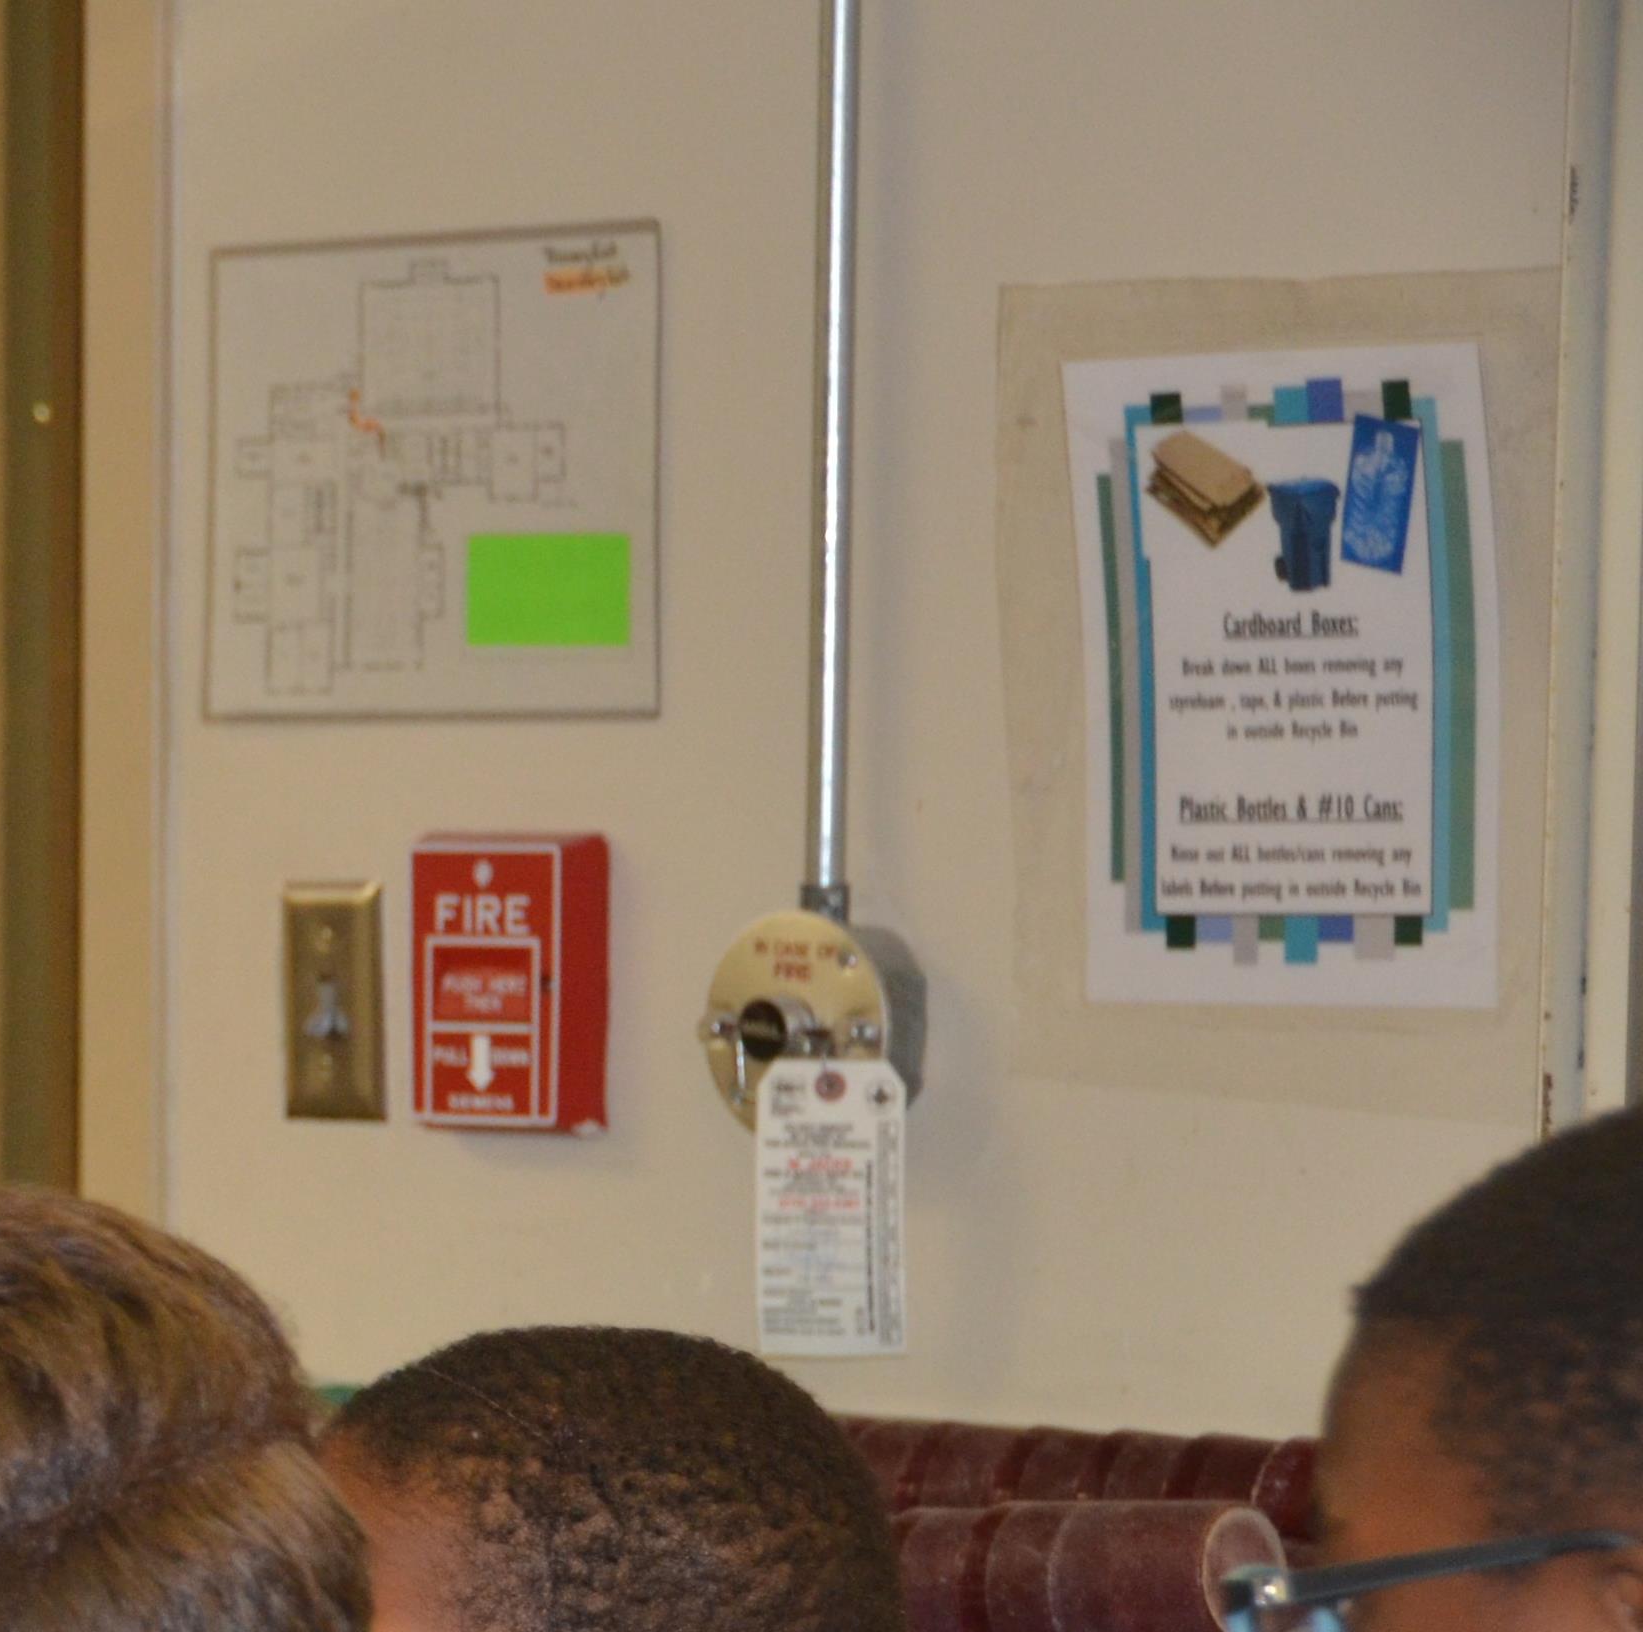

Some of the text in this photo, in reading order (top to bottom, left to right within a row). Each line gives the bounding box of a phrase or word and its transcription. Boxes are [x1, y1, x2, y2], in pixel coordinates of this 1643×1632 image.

[1223, 610, 1359, 638] Cardboard Boxes:
[1182, 657, 1404, 678] Break down ALL boxes removing any
[1289, 691, 1325, 711] plastic
[1332, 688, 1369, 707] Before
[1375, 690, 1418, 711] putting
[1226, 719, 1359, 742] in outside Recycle Bin
[1179, 793, 1404, 823] Plastic Bottles & #10 Cans:
[1231, 844, 1251, 863] ALL
[1332, 846, 1385, 867] removing
[1392, 847, 1412, 867] any
[1200, 878, 1235, 897] Before
[1242, 880, 1283, 902] putting
[1306, 879, 1347, 897] outside
[1354, 878, 1395, 900] Recycle
[1403, 877, 1422, 897] Bin
[434, 893, 532, 937] FIRE
[773, 962, 813, 982] FIRE
